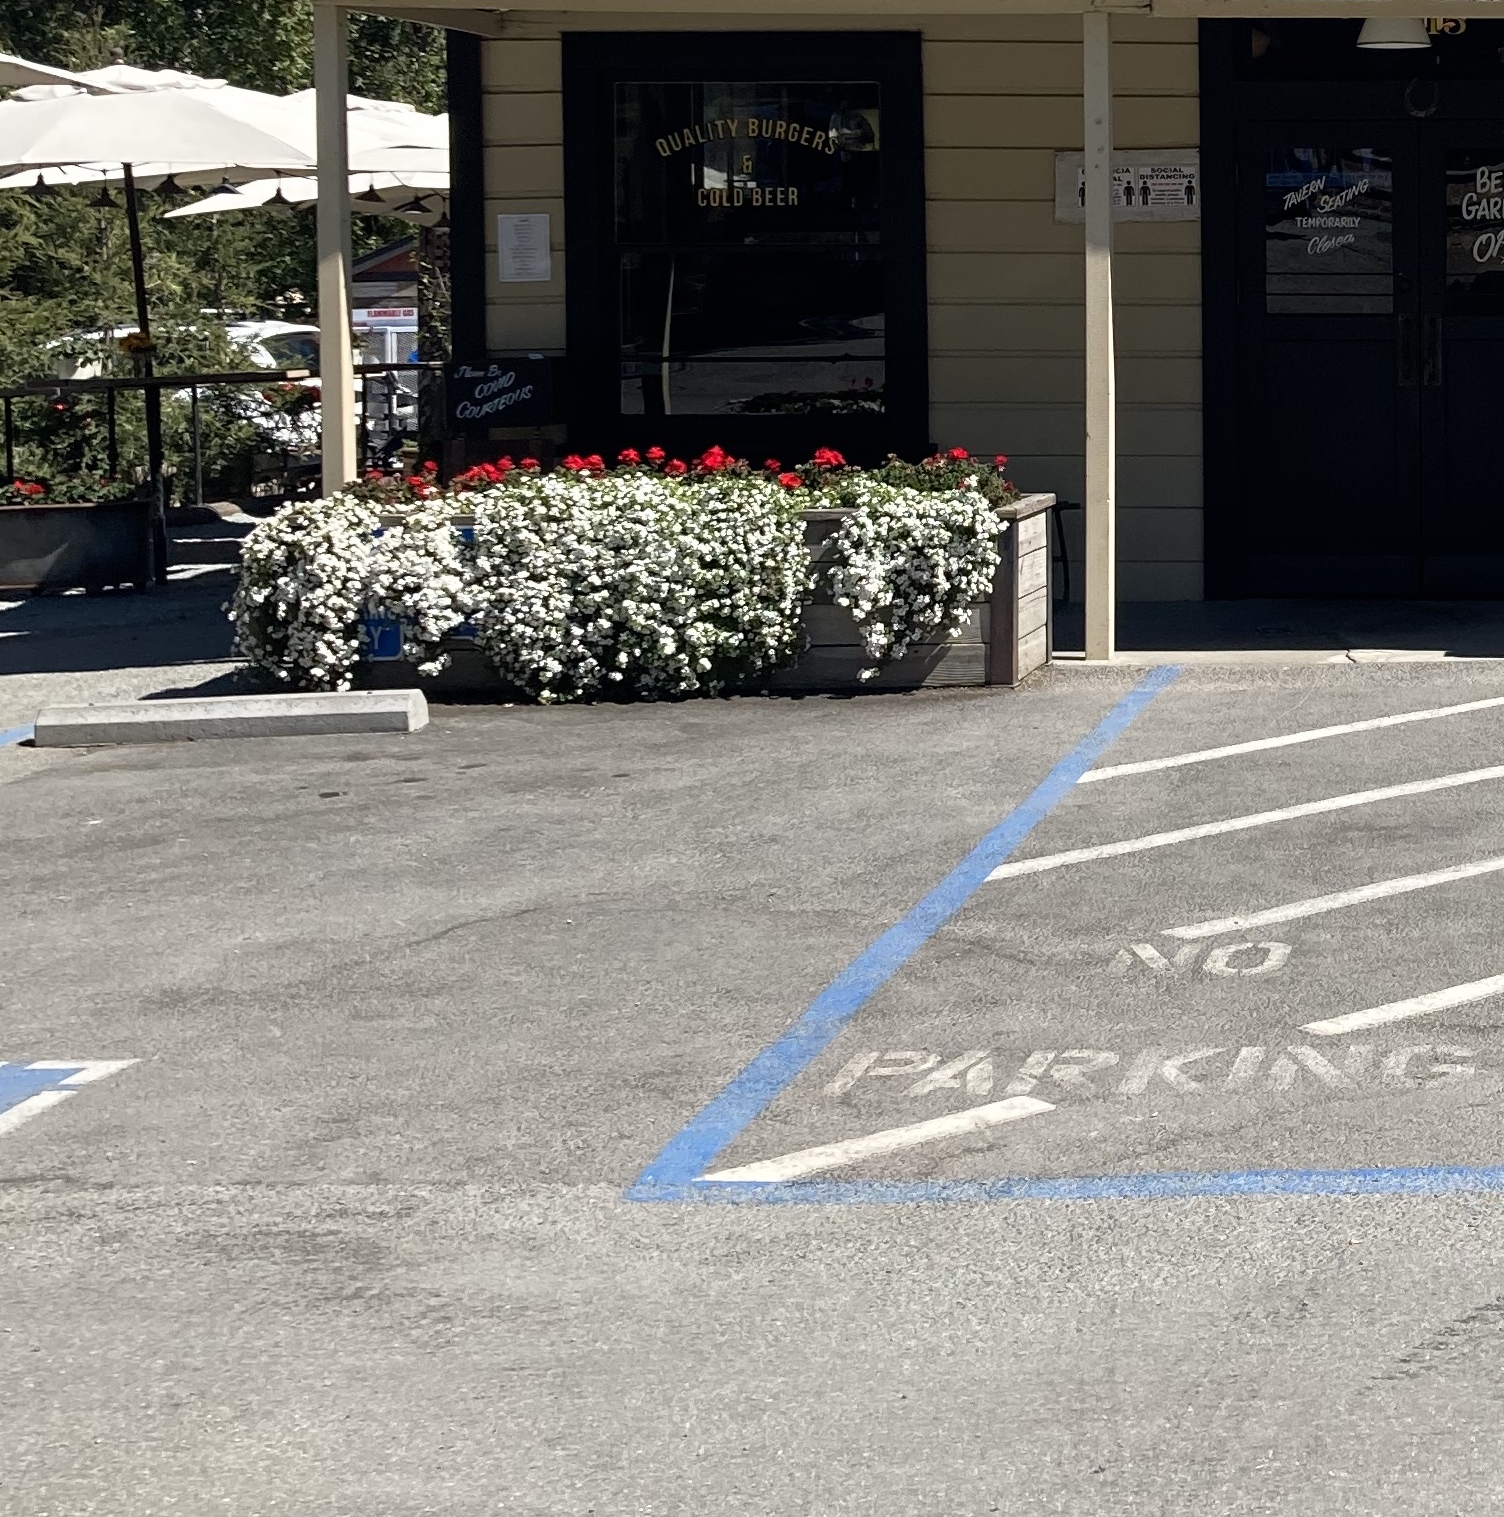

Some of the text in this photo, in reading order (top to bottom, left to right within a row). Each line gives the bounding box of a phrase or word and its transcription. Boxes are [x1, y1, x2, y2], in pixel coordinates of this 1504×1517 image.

[655, 118, 838, 157] QUALITY BURGERS
[742, 155, 753, 173] &
[697, 187, 799, 207] COLD BEER
[1282, 175, 1370, 214] TAVERN SEATING
[1295, 216, 1361, 229] TEMPORARILY
[1108, 941, 1292, 978] NO
[823, 1044, 1482, 1096] PARKING
